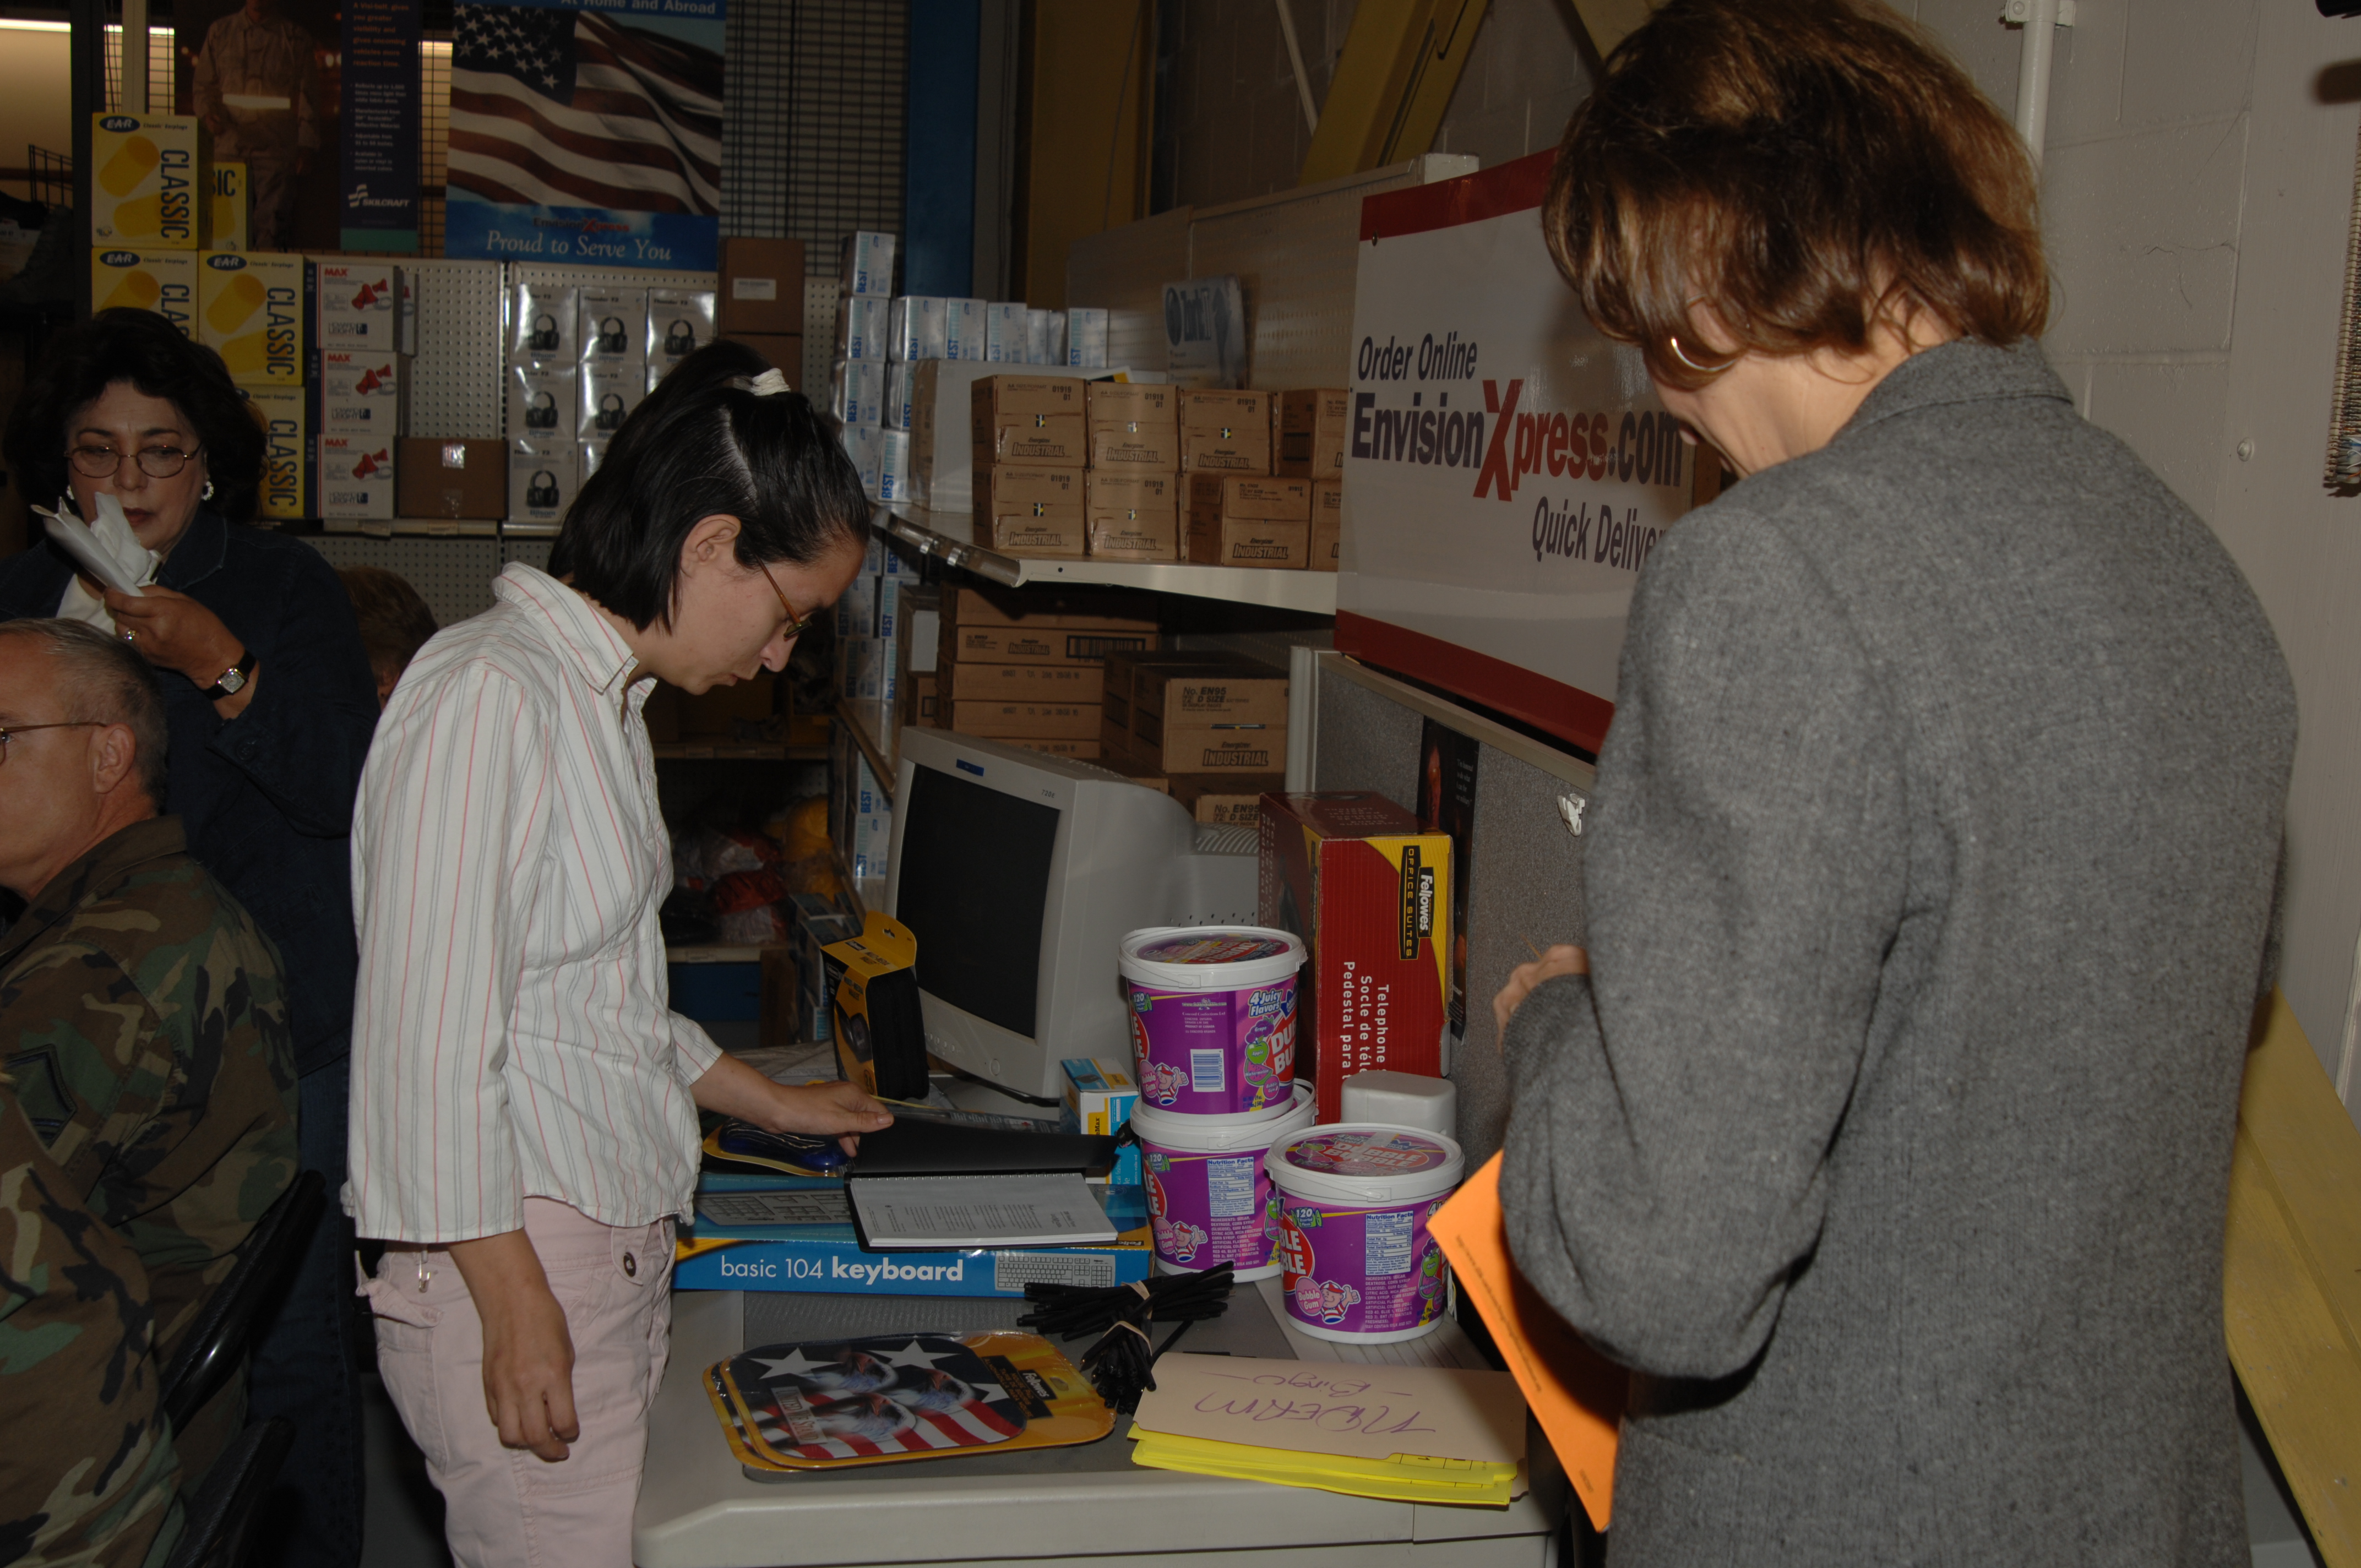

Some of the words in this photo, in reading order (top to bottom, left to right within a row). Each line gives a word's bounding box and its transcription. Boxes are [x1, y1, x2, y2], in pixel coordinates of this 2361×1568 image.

[632, 0, 658, 10] and
[663, 0, 716, 15] Abroad
[160, 149, 190, 239] CLASSIC
[486, 229, 543, 253] Proud
[551, 238, 569, 254] to
[576, 235, 626, 258] Serve
[634, 238, 672, 261] You
[324, 268, 348, 276] MAX
[856, 270, 868, 293] BEST
[266, 287, 296, 375] CLASSIC
[327, 353, 351, 362] MAX
[992, 343, 1001, 361] EST
[1070, 347, 1081, 366] EST
[1358, 335, 1413, 382] Order
[1417, 330, 1478, 382] Online
[847, 399, 857, 422] BEST
[324, 438, 348, 447] MAX
[1351, 378, 1683, 502] EnvisionXpress.com
[1011, 442, 1065, 457] INDUSTRIAL
[1106, 447, 1158, 463] INDUSTRIAL
[269, 419, 298, 507] CLASSIC
[1198, 453, 1249, 469] INDUSTRIAL
[882, 473, 895, 499] BEST
[1051, 474, 1070, 482] 01919
[1532, 496, 1592, 563] Quick
[1009, 531, 1062, 546] INDUSTRIAL
[1104, 535, 1157, 551] INDUSTRIAL
[1232, 543, 1288, 559] INDUSTRIAL
[881, 614, 893, 636] BEST
[1008, 642, 1050, 656] INDUSTRIAL
[1183, 687, 1198, 696] No.
[1200, 687, 1227, 695] EN95
[1202, 749, 1269, 767] INDUSTRIAL
[860, 790, 872, 813] BEST
[1214, 804, 1230, 813] No.
[1232, 804, 1260, 814] EN95
[1407, 848, 1415, 899] OFFICE
[1419, 874, 1433, 932] Fellowes
[1133, 993, 1145, 1002] 120
[1249, 991, 1261, 1005] 4
[1261, 989, 1282, 1004] Juicy
[1342, 961, 1356, 1029] Pedestal
[1359, 975, 1373, 1017] Socle
[1249, 1001, 1281, 1016] Flavors
[1359, 1022, 1372, 1041] de
[1374, 984, 1390, 1064] Telephone
[1339, 1035, 1352, 1069] para
[1141, 1071, 1157, 1084] Bubble
[1145, 1083, 1157, 1093] Gum
[1149, 1153, 1162, 1162] 120
[1296, 1208, 1313, 1218] 120
[1157, 1231, 1173, 1240] Bubble
[1161, 1240, 1173, 1249] Gum
[721, 1255, 777, 1277] basic
[785, 1257, 824, 1279] 104
[831, 1255, 964, 1286] keyboard
[1298, 1291, 1320, 1301] Bubble
[1303, 1300, 1319, 1310] Gum
[1022, 1372, 1050, 1397] Fellowes
[1253, 1372, 1372, 1397] Bingo
